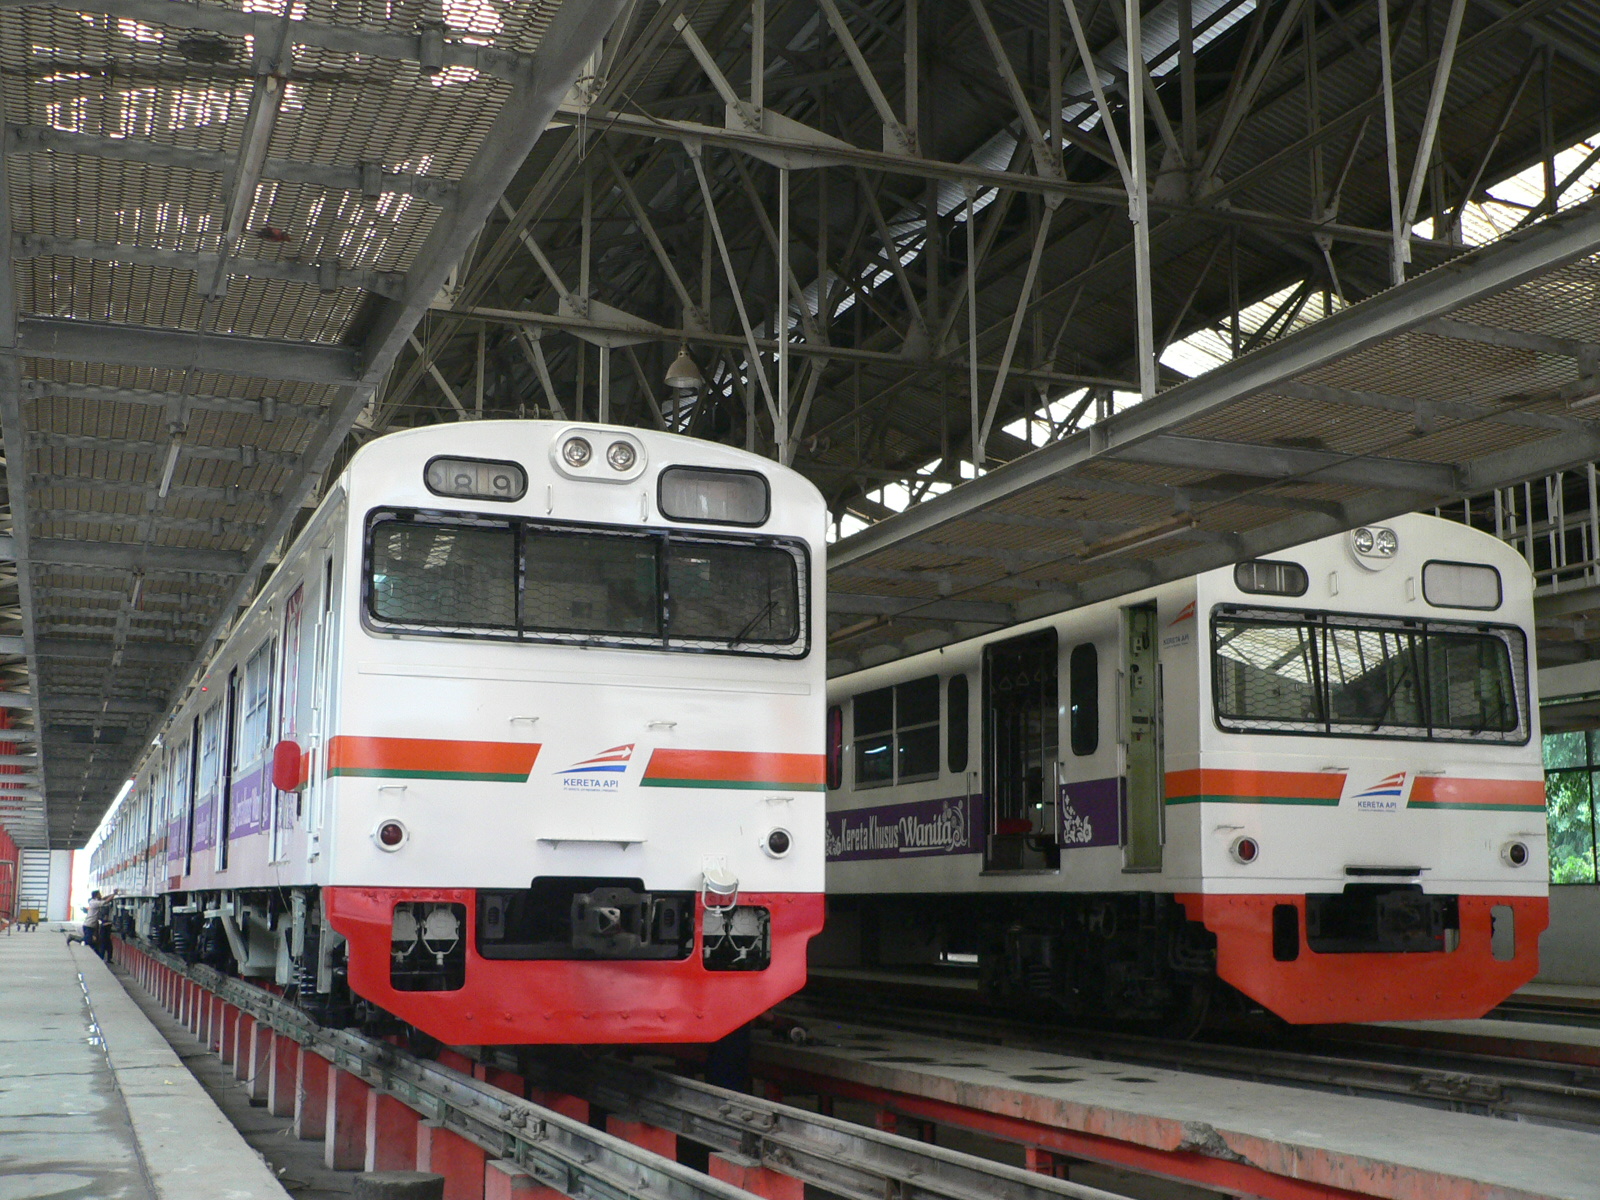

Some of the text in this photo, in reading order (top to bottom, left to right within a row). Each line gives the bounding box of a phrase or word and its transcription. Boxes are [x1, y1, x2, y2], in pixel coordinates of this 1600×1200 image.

[563, 778, 619, 788] KERETA API
[1357, 801, 1397, 809] KERETA API
[841, 813, 954, 851] Kereta Khusus Wanita
